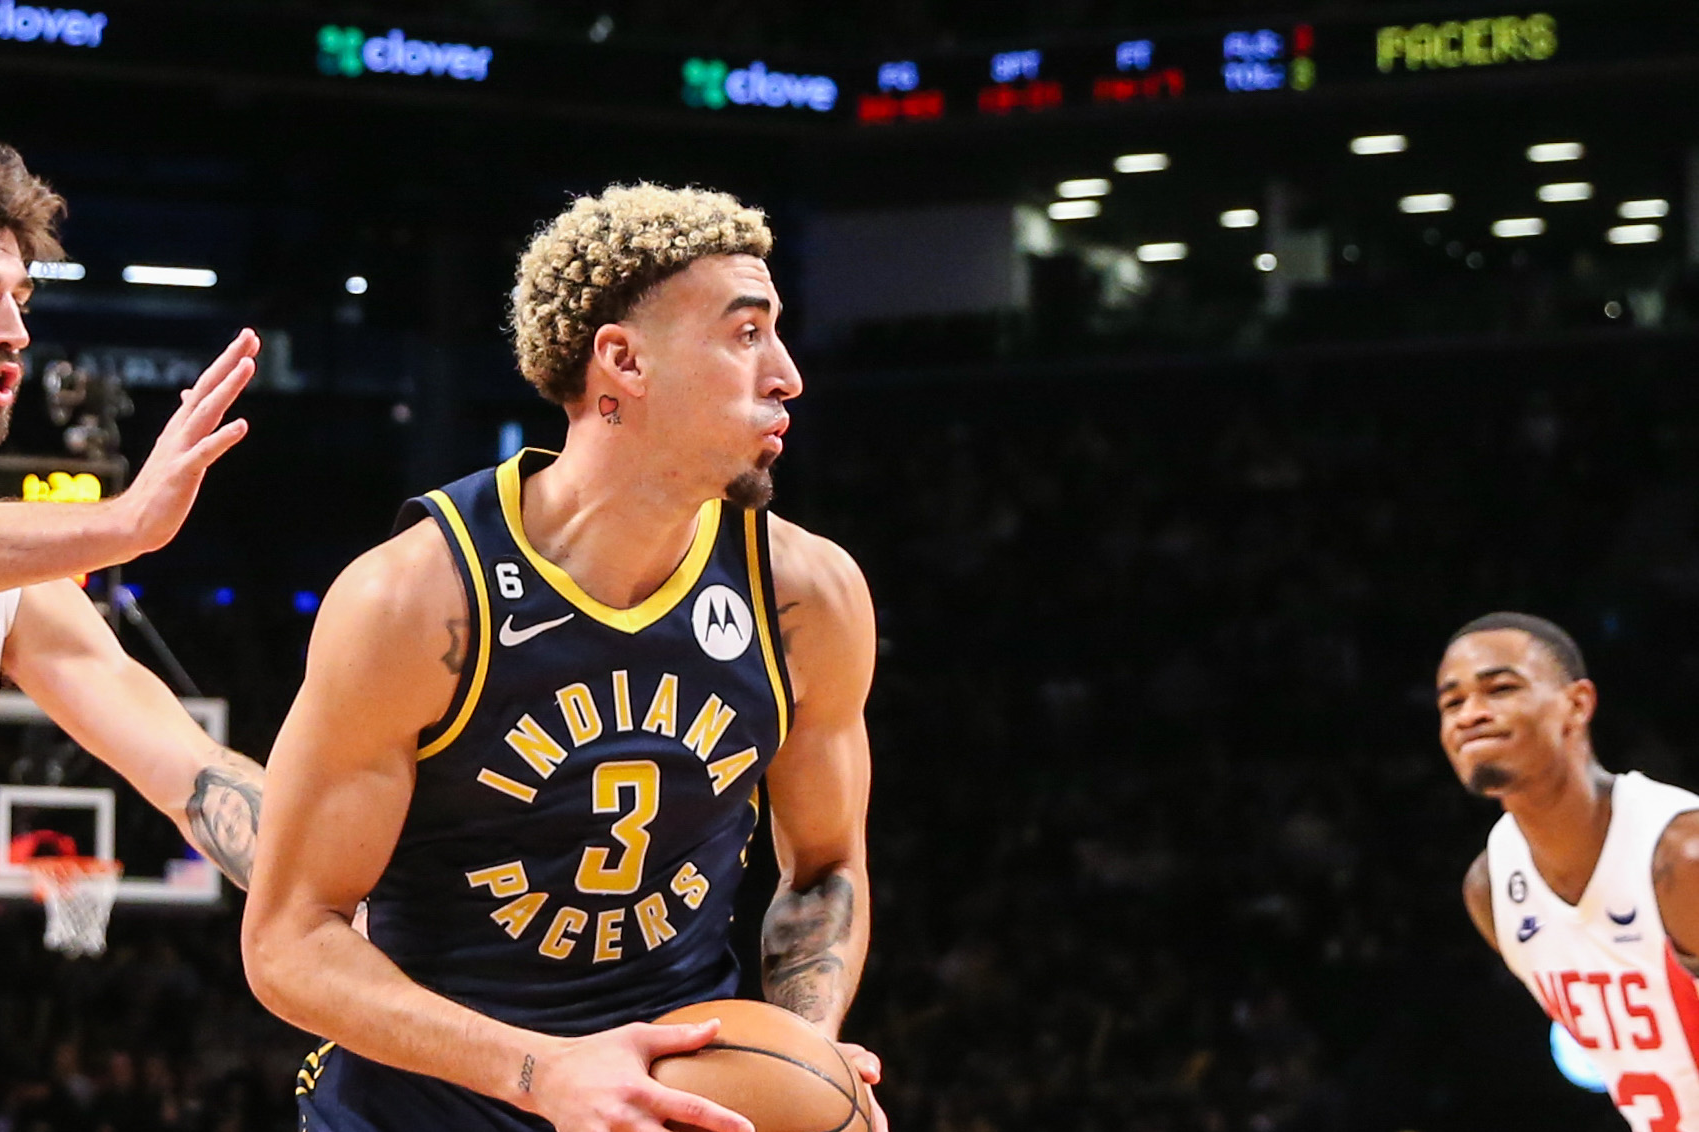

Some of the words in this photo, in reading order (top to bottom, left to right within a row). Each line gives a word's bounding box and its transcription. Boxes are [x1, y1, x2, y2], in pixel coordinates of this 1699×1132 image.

[362, 28, 493, 82] clover
[1377, 13, 1557, 73] PACERS
[495, 561, 524, 599] 6
[477, 670, 759, 804] INDIANA
[575, 760, 660, 894] 3
[465, 861, 710, 963] PACERS
